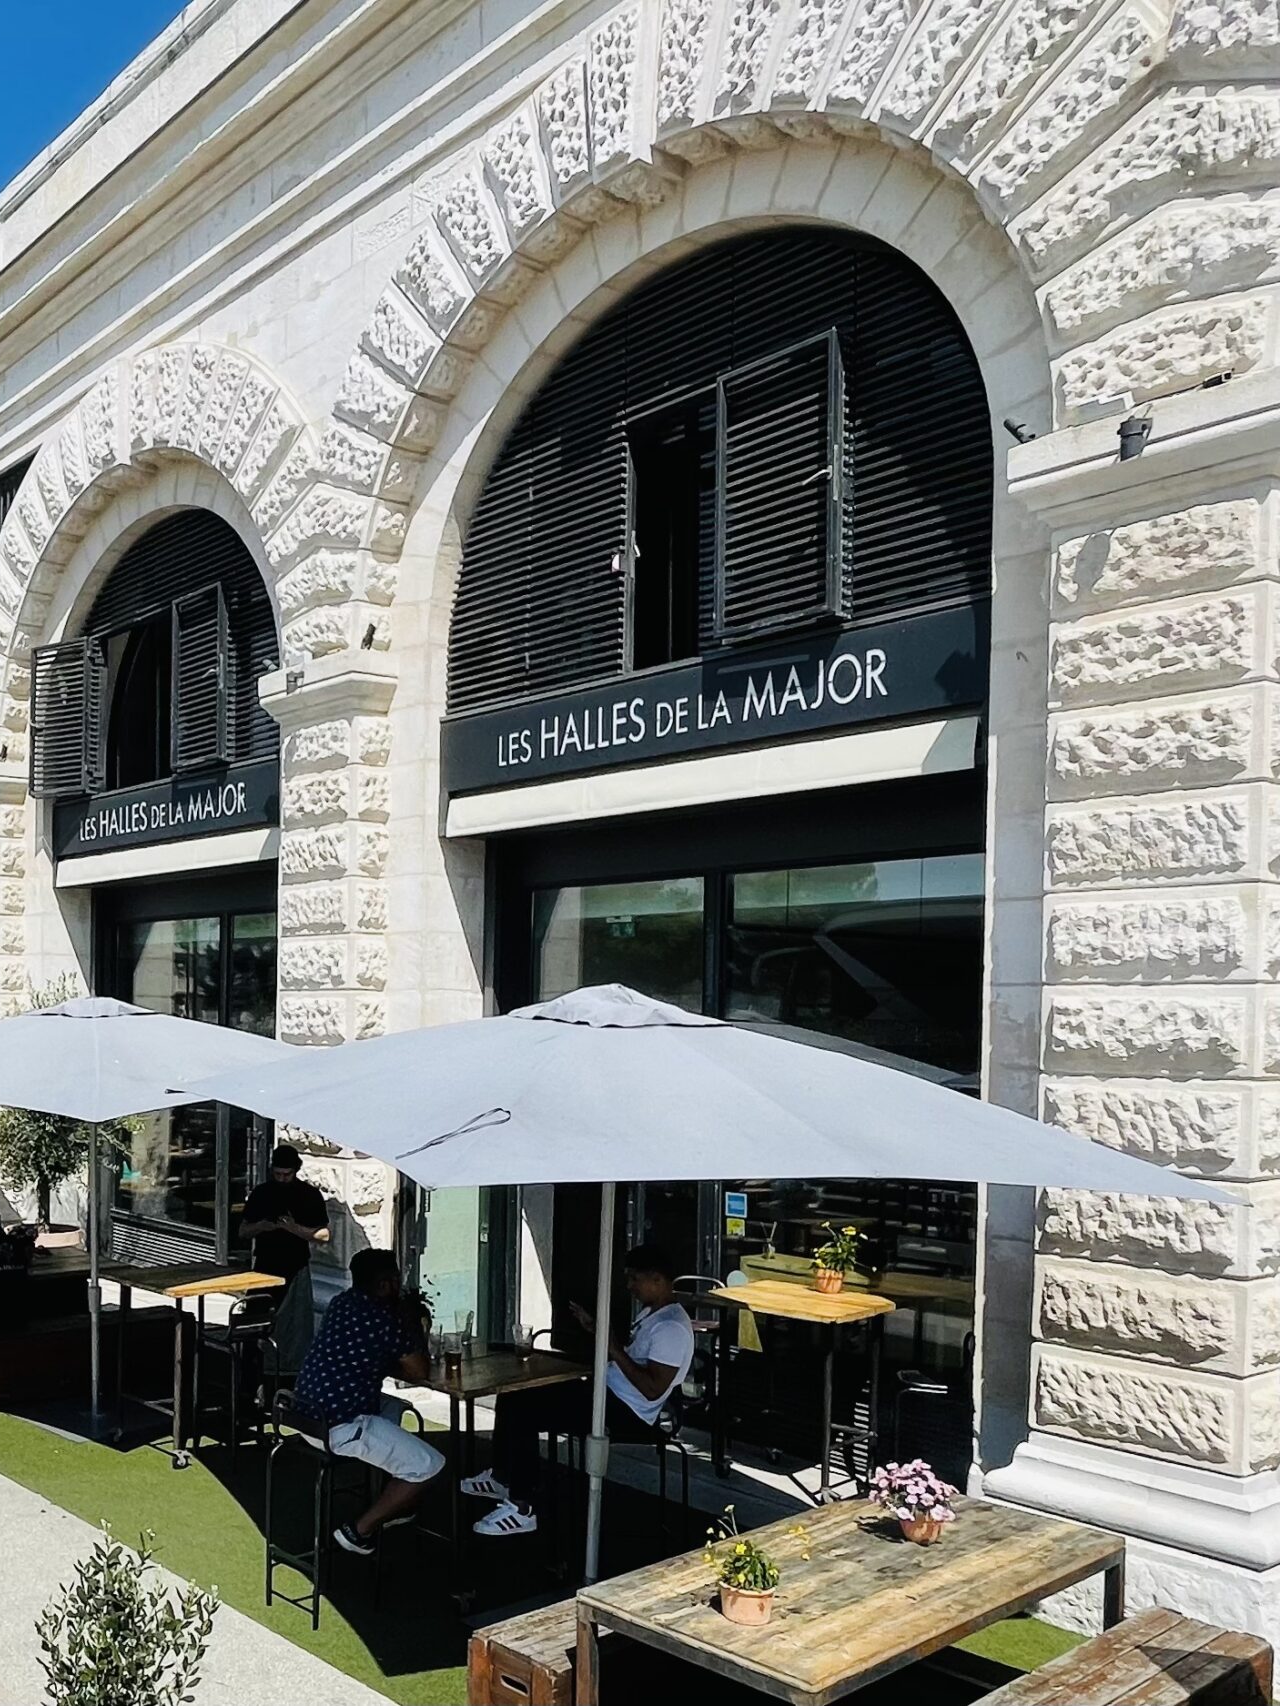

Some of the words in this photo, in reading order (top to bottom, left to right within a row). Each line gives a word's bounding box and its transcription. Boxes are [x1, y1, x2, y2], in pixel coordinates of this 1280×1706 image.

[498, 729, 532, 767] LES
[540, 697, 646, 759] HALLES
[656, 697, 689, 738] DE
[697, 689, 732, 730] LA
[742, 648, 888, 722] MAJOR
[80, 817, 96, 841] LES
[99, 801, 147, 838] HALLES
[151, 805, 166, 828] DE
[169, 801, 185, 826] LA
[187, 782, 247, 823] MAJOR
